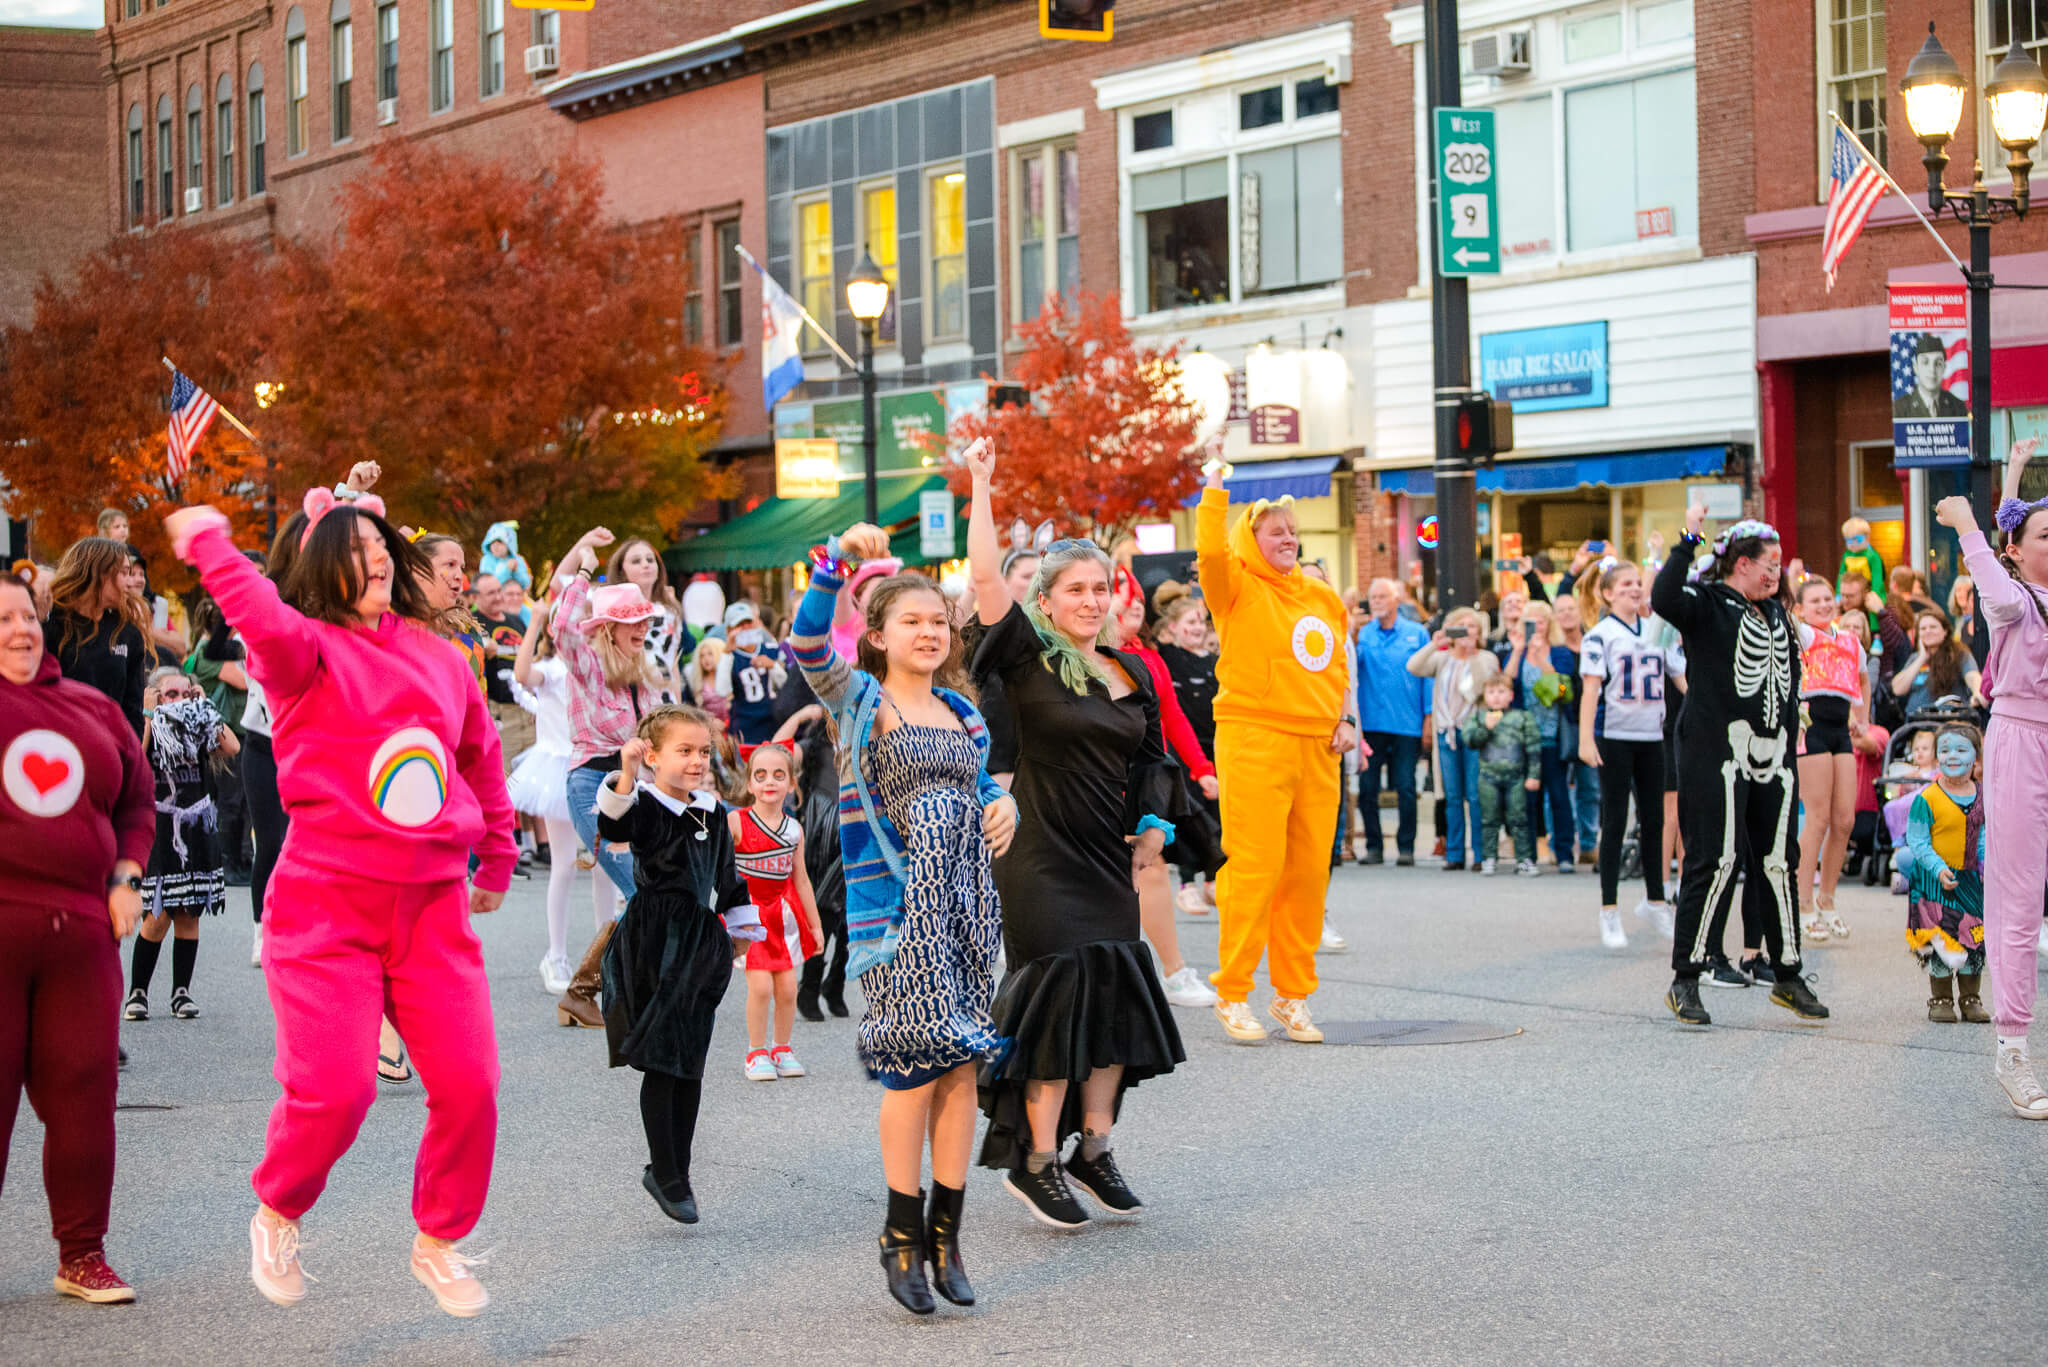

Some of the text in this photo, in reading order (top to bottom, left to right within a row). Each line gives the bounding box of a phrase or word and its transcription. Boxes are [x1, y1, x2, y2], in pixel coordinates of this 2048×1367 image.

[1449, 153, 1487, 174] 202
[1464, 205, 1477, 226] 9
[1892, 295, 1963, 304] HOMETOWN HEROES
[1485, 356, 1523, 380] HAIR
[1551, 348, 1603, 375] SALON
[1927, 423, 1955, 434] ARMY
[1907, 435, 1932, 446] WORLD
[1933, 435, 1948, 446] WAR
[1616, 652, 1663, 703] 12
